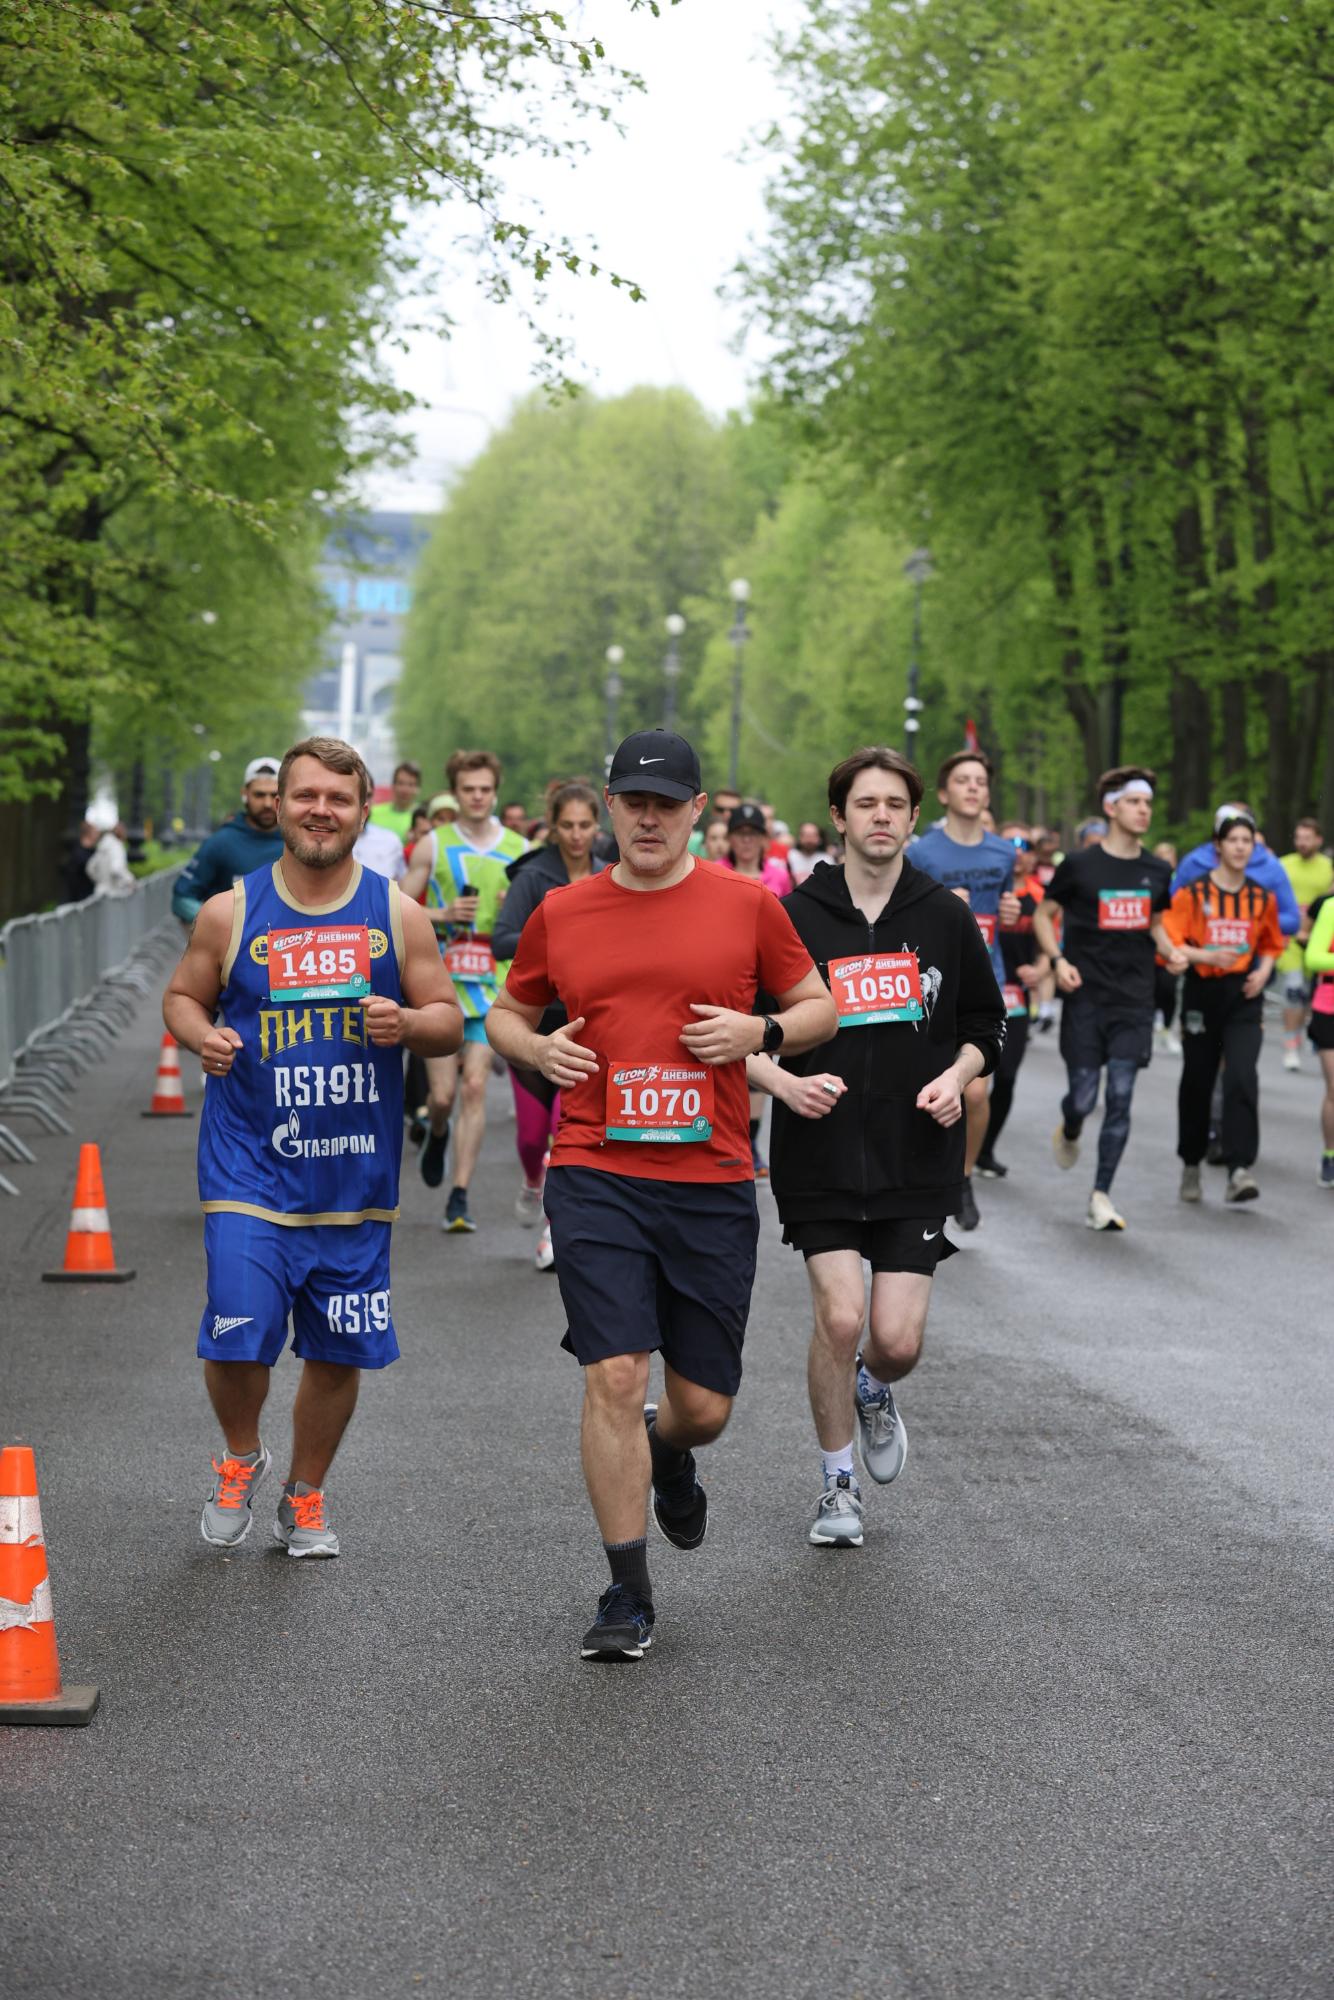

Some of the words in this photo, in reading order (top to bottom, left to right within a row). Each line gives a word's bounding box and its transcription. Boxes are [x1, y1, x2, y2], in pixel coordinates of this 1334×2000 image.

[273, 933, 303, 951] БЕГОМ
[317, 932, 361, 943] ДНЕВНИК
[282, 948, 357, 978] 1485
[843, 974, 911, 1004] 1050
[274, 1062, 380, 1107] RS1912
[613, 1068, 646, 1083] БЕГОМ
[661, 1071, 707, 1080] ДНЕВНИК
[620, 1088, 701, 1116] 1070
[696, 1120, 705, 1128] 10
[304, 1135, 376, 1158] ГАЗПРОМ
[327, 1289, 392, 1334] RS19
